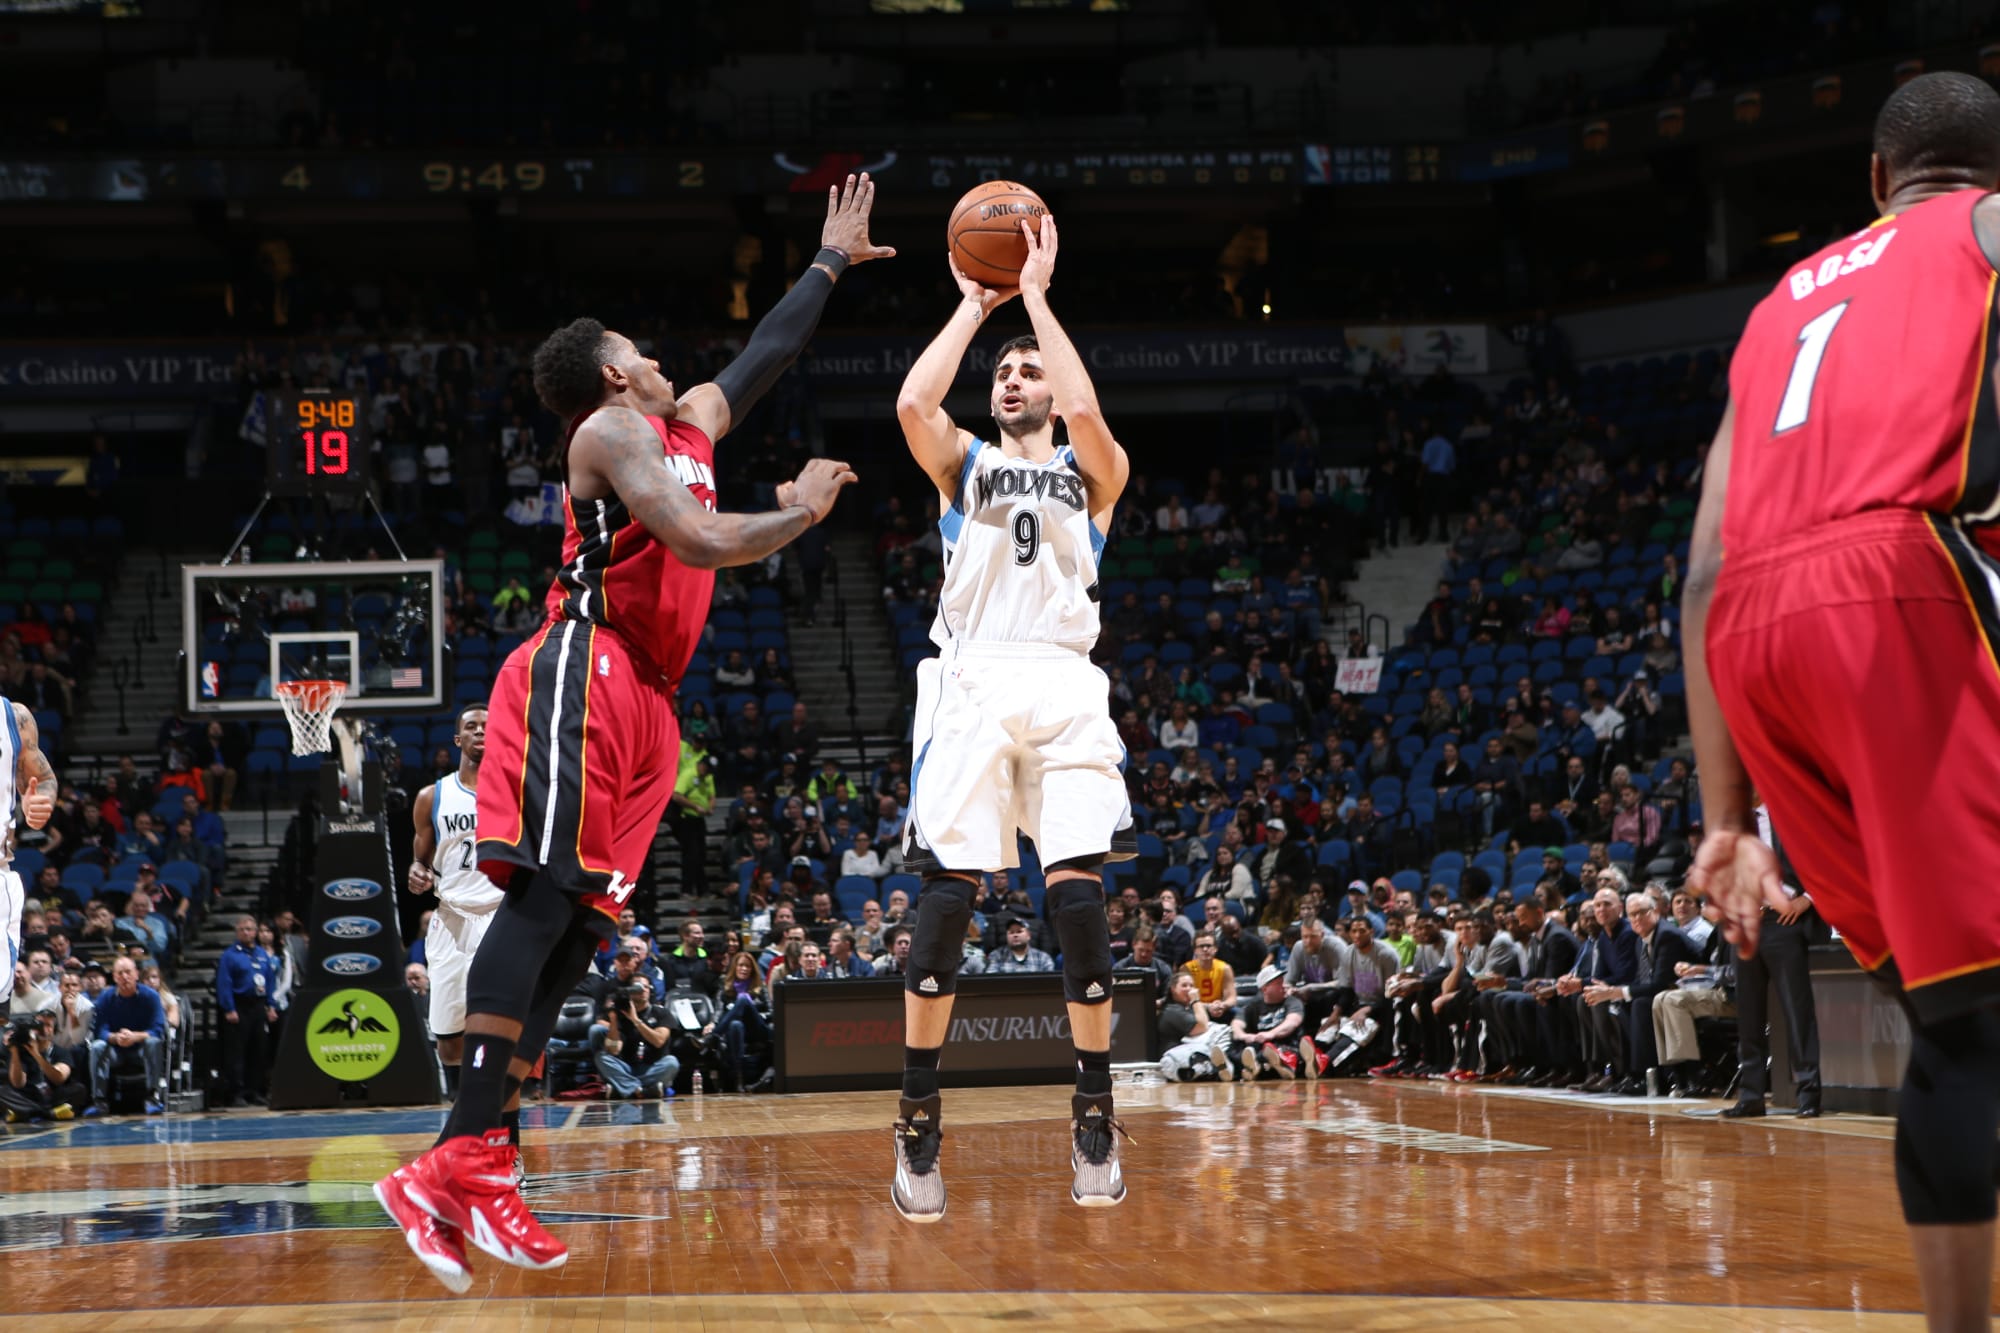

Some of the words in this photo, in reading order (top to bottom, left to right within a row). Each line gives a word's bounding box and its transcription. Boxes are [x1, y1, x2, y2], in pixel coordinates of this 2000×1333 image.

[281, 163, 312, 190] 4
[423, 161, 546, 192] 9:49
[678, 161, 705, 188] 2
[18, 358, 118, 386] Casino
[123, 357, 183, 384] VIP
[789, 355, 877, 376] asure
[881, 348, 914, 375] Isl
[1090, 343, 1181, 370] Casino
[1187, 341, 1239, 367] VIP
[1245, 339, 1344, 366] Terrace
[1769, 296, 1853, 438] 1
[298, 400, 354, 428] 9:48
[302, 431, 348, 474] 19
[976, 466, 1086, 511] WOLVES
[1012, 509, 1040, 567] 9
[327, 820, 377, 834] SPALDING
[442, 812, 479, 839] WOL
[459, 839, 475, 871] 2
[332, 882, 372, 898] Ford
[332, 921, 372, 936] Ford
[332, 959, 372, 974] Ford
[810, 1020, 905, 1048] FEDERA
[949, 1014, 1073, 1043] INSURANC
[320, 1043, 387, 1054] MINNESOTA
[325, 1053, 381, 1064] LOTTERY
